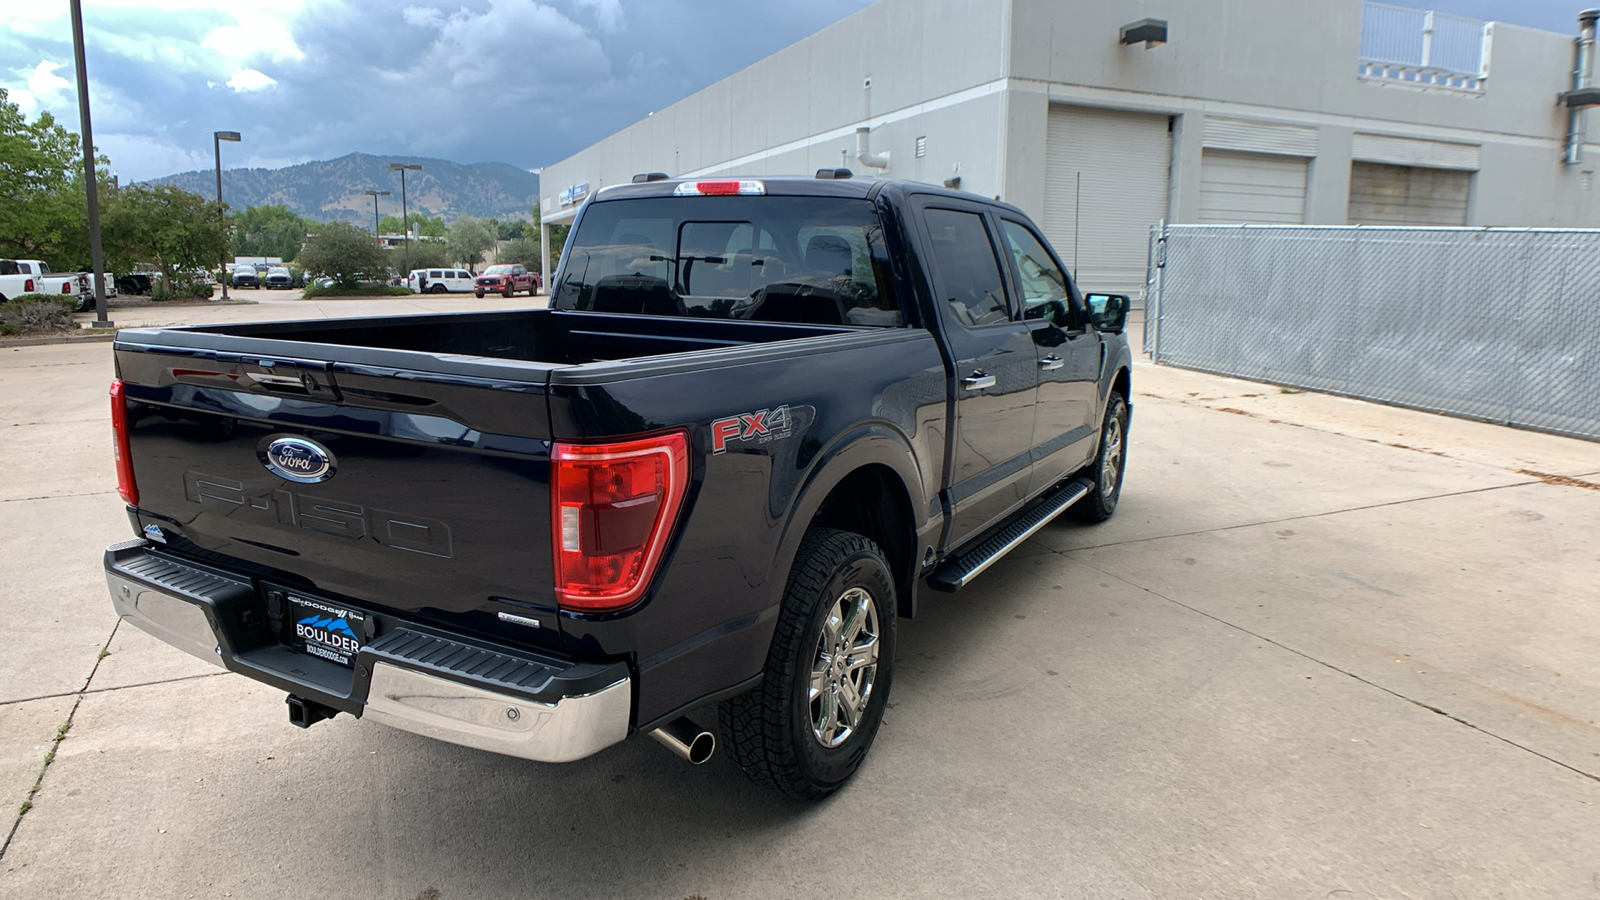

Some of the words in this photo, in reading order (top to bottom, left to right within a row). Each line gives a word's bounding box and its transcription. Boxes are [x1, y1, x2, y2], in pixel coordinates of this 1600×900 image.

[711, 404, 792, 456] FX4
[278, 445, 312, 470] Ford
[182, 470, 453, 559] F-150
[296, 623, 360, 653] BOULDER
[306, 644, 349, 665] BOULDERDODGE.COM
